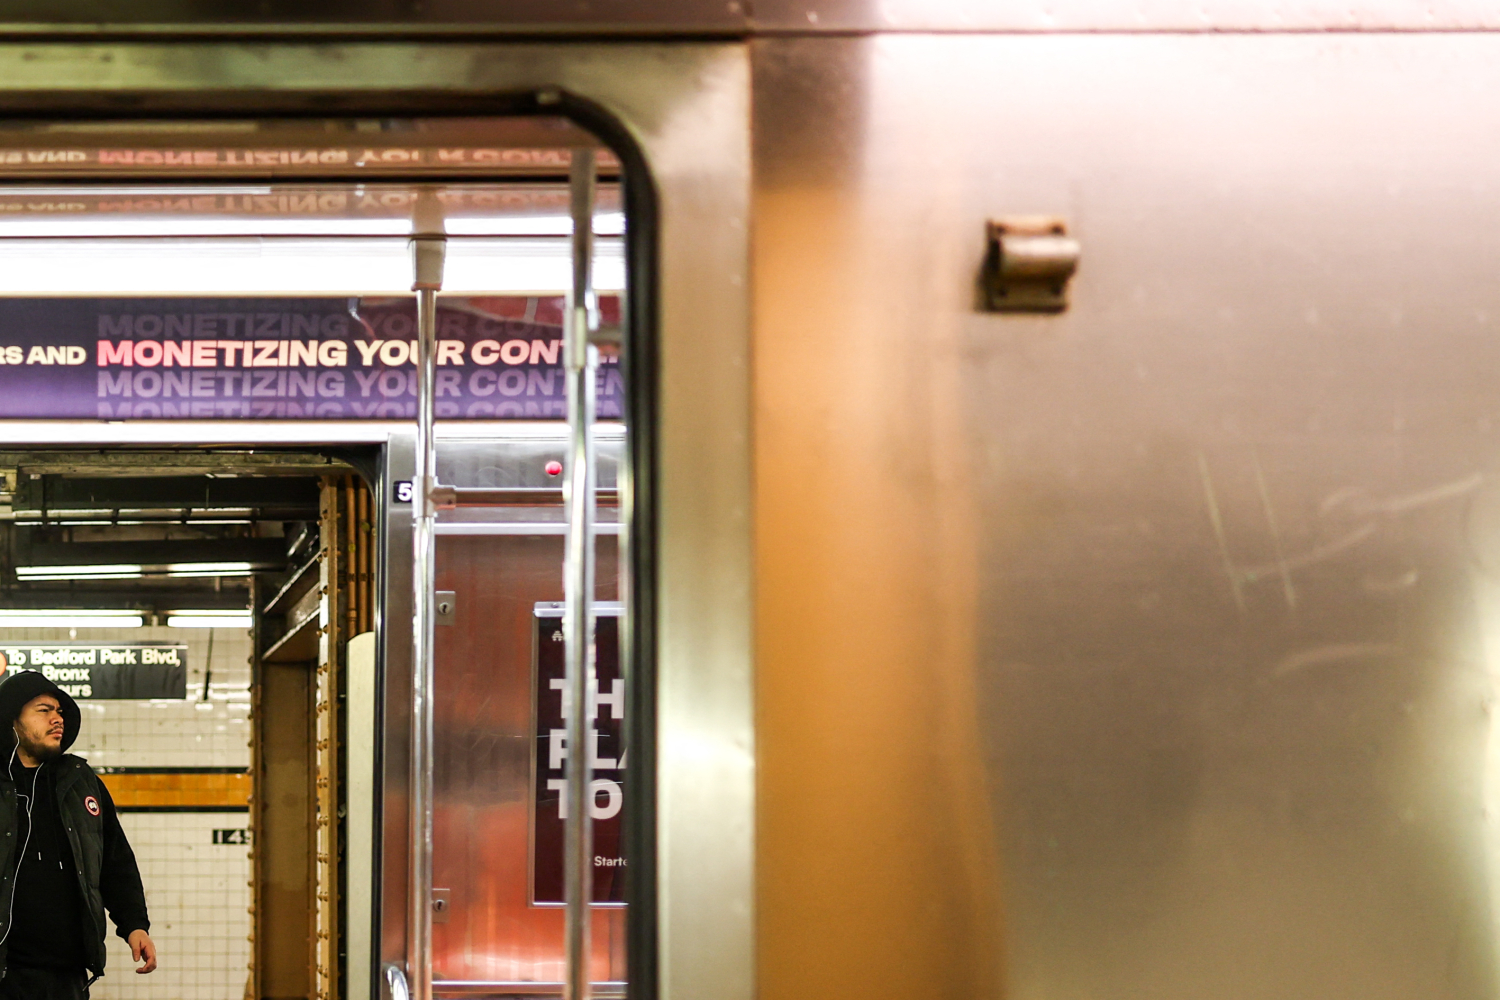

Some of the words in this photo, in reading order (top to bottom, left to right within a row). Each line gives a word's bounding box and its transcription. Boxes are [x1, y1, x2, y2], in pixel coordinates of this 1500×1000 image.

[26, 345, 86, 365] AND
[97, 340, 347, 367] MONETIZING
[97, 370, 345, 397] MONETIZING
[397, 483, 412, 501] 5
[5, 650, 27, 665] To
[30, 650, 96, 665] Bedford
[100, 650, 137, 665] Park
[141, 650, 181, 667] Blvd,
[41, 665, 91, 682] Bronx
